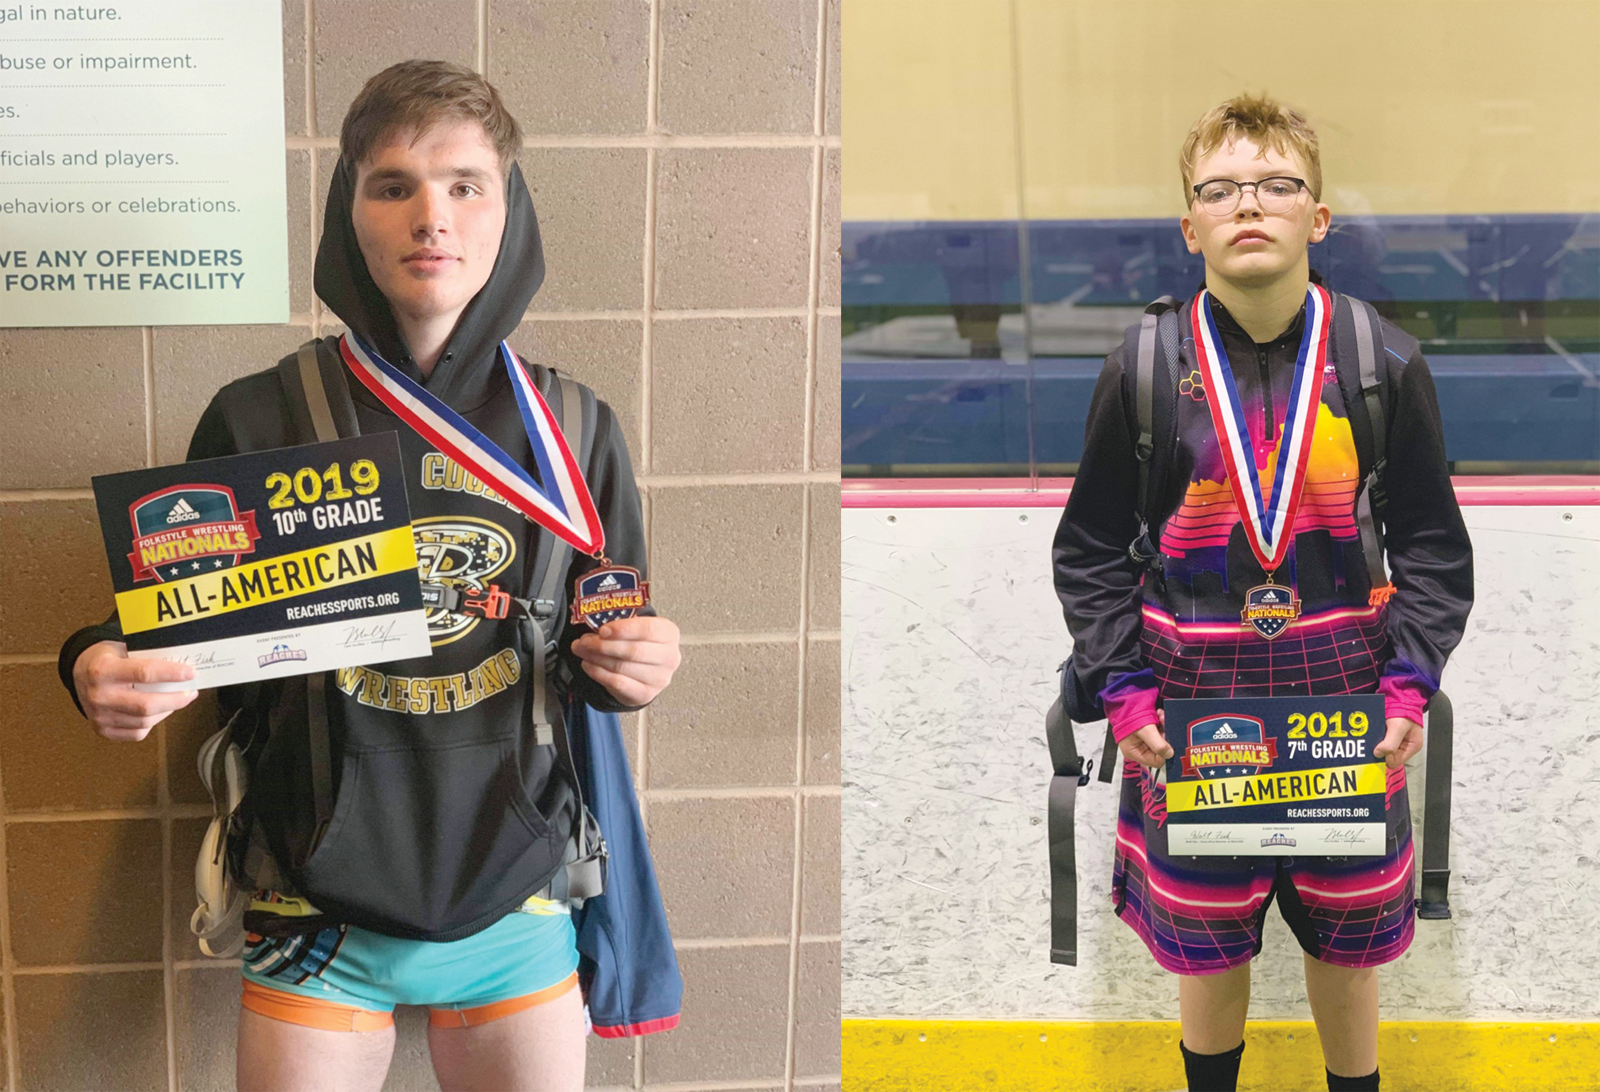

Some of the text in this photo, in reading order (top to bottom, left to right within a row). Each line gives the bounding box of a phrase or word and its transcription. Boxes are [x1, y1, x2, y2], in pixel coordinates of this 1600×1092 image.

[30, 5, 47, 21] in
[54, 6, 122, 21] nature.
[0, 53, 198, 72] buse or impairment.
[62, 150, 98, 166] and
[105, 150, 179, 169] players.
[0, 197, 242, 214] ehaviors or celebrations.
[36, 250, 88, 268] ANY
[96, 249, 244, 267] OFFENDERS
[5, 272, 246, 292] FORM THE FACILITY
[265, 459, 381, 510] 2019
[166, 511, 201, 524] adidas
[272, 497, 385, 536] 10th GRADE
[139, 524, 245, 549] FOLKSTYLE WRESTLING
[140, 532, 250, 567] NATIONALS
[156, 541, 378, 622] ALL-AMERICAN
[286, 592, 400, 621] REACHESSPORTS.ORG
[580, 595, 643, 615] NATIONALS
[1247, 608, 1296, 618] NATIONALS
[258, 649, 307, 668] REACHES
[336, 647, 522, 715] WRESTLING
[1287, 710, 1369, 739] 2019
[1189, 750, 1270, 768] NATIONALS
[1190, 744, 1268, 755] FOLKSTYLE WRESTLING
[1287, 739, 1366, 760] 7th GRADE
[1194, 770, 1358, 807] ALL-AMERICAN
[1287, 808, 1370, 818] REACHESSPORTS.ORG
